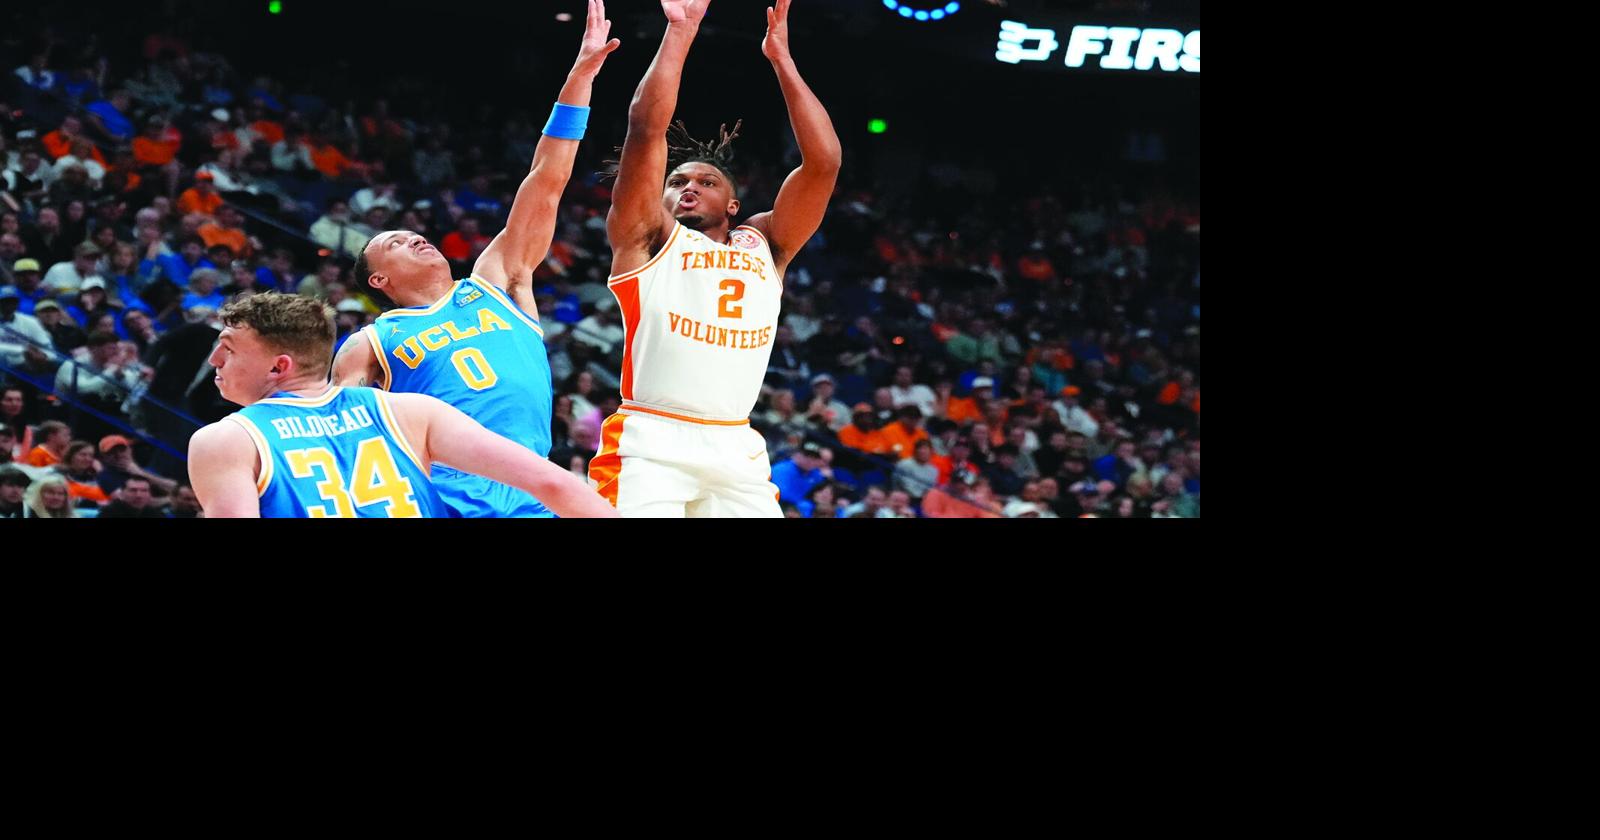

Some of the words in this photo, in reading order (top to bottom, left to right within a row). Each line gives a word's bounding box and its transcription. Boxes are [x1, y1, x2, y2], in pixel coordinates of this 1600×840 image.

[717, 278, 745, 319] 2
[392, 308, 512, 369] UCLA
[450, 347, 498, 391] 0
[284, 435, 422, 518] 34
